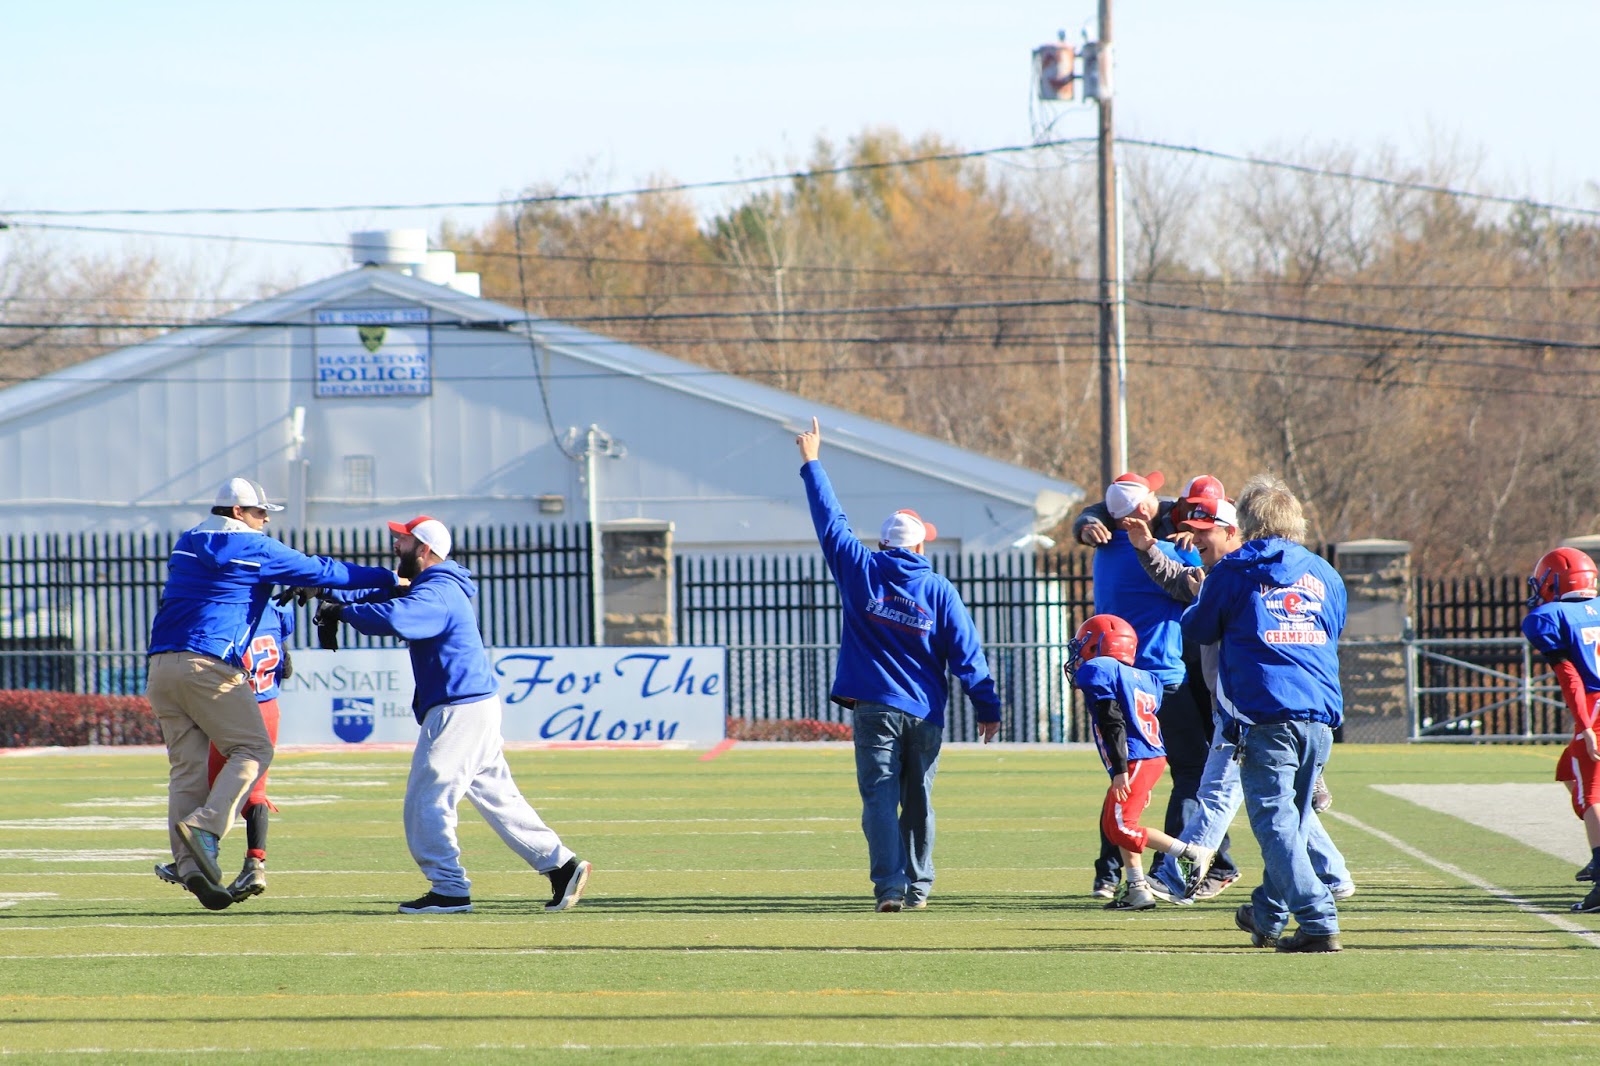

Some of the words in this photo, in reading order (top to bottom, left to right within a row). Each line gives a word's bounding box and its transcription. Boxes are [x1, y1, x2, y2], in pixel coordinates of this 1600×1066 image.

[319, 355, 426, 365] HAZLETON
[319, 366, 427, 382] POLICE
[865, 598, 934, 631] FRACKVILLE
[1265, 631, 1326, 643] CHAMPIONS
[281, 665, 399, 691] ENNSTATE
[494, 653, 601, 704] For
[614, 653, 720, 698] The
